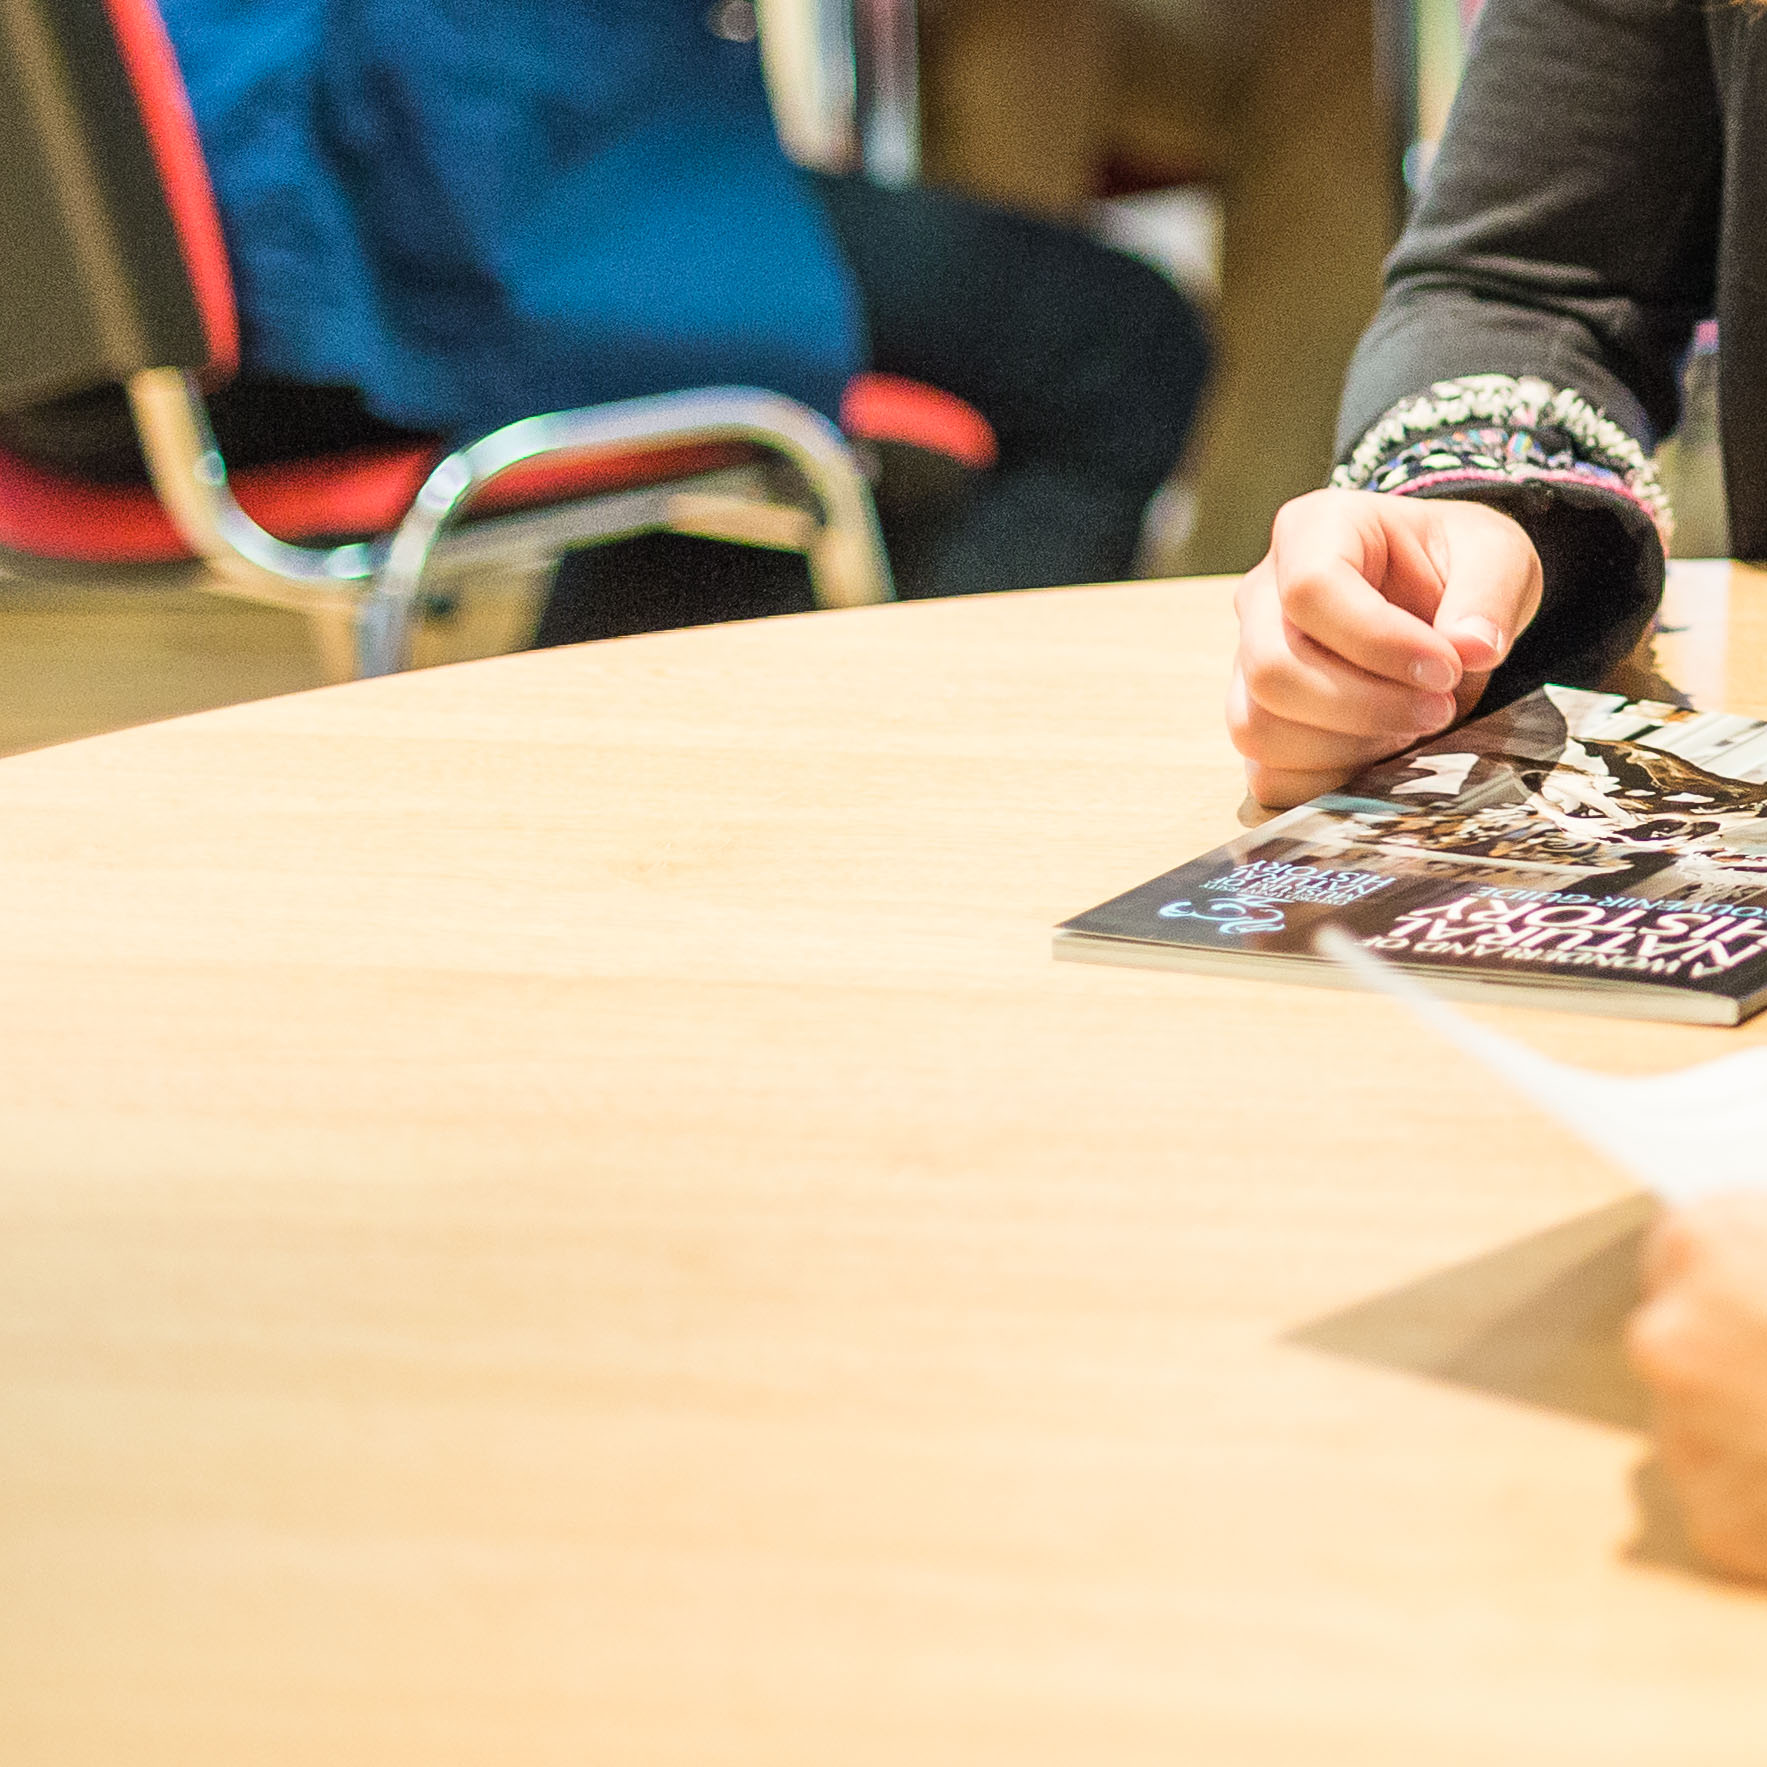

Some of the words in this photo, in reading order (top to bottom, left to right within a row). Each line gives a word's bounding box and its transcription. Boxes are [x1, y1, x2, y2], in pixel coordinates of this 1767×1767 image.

[1228, 868, 1379, 896] NATURAL
[1232, 860, 1397, 888] HISTORY
[1469, 886, 1591, 904] GUIDE
[1387, 915, 1762, 968] NATURAL
[1412, 941, 1682, 973] WONDERLAND
